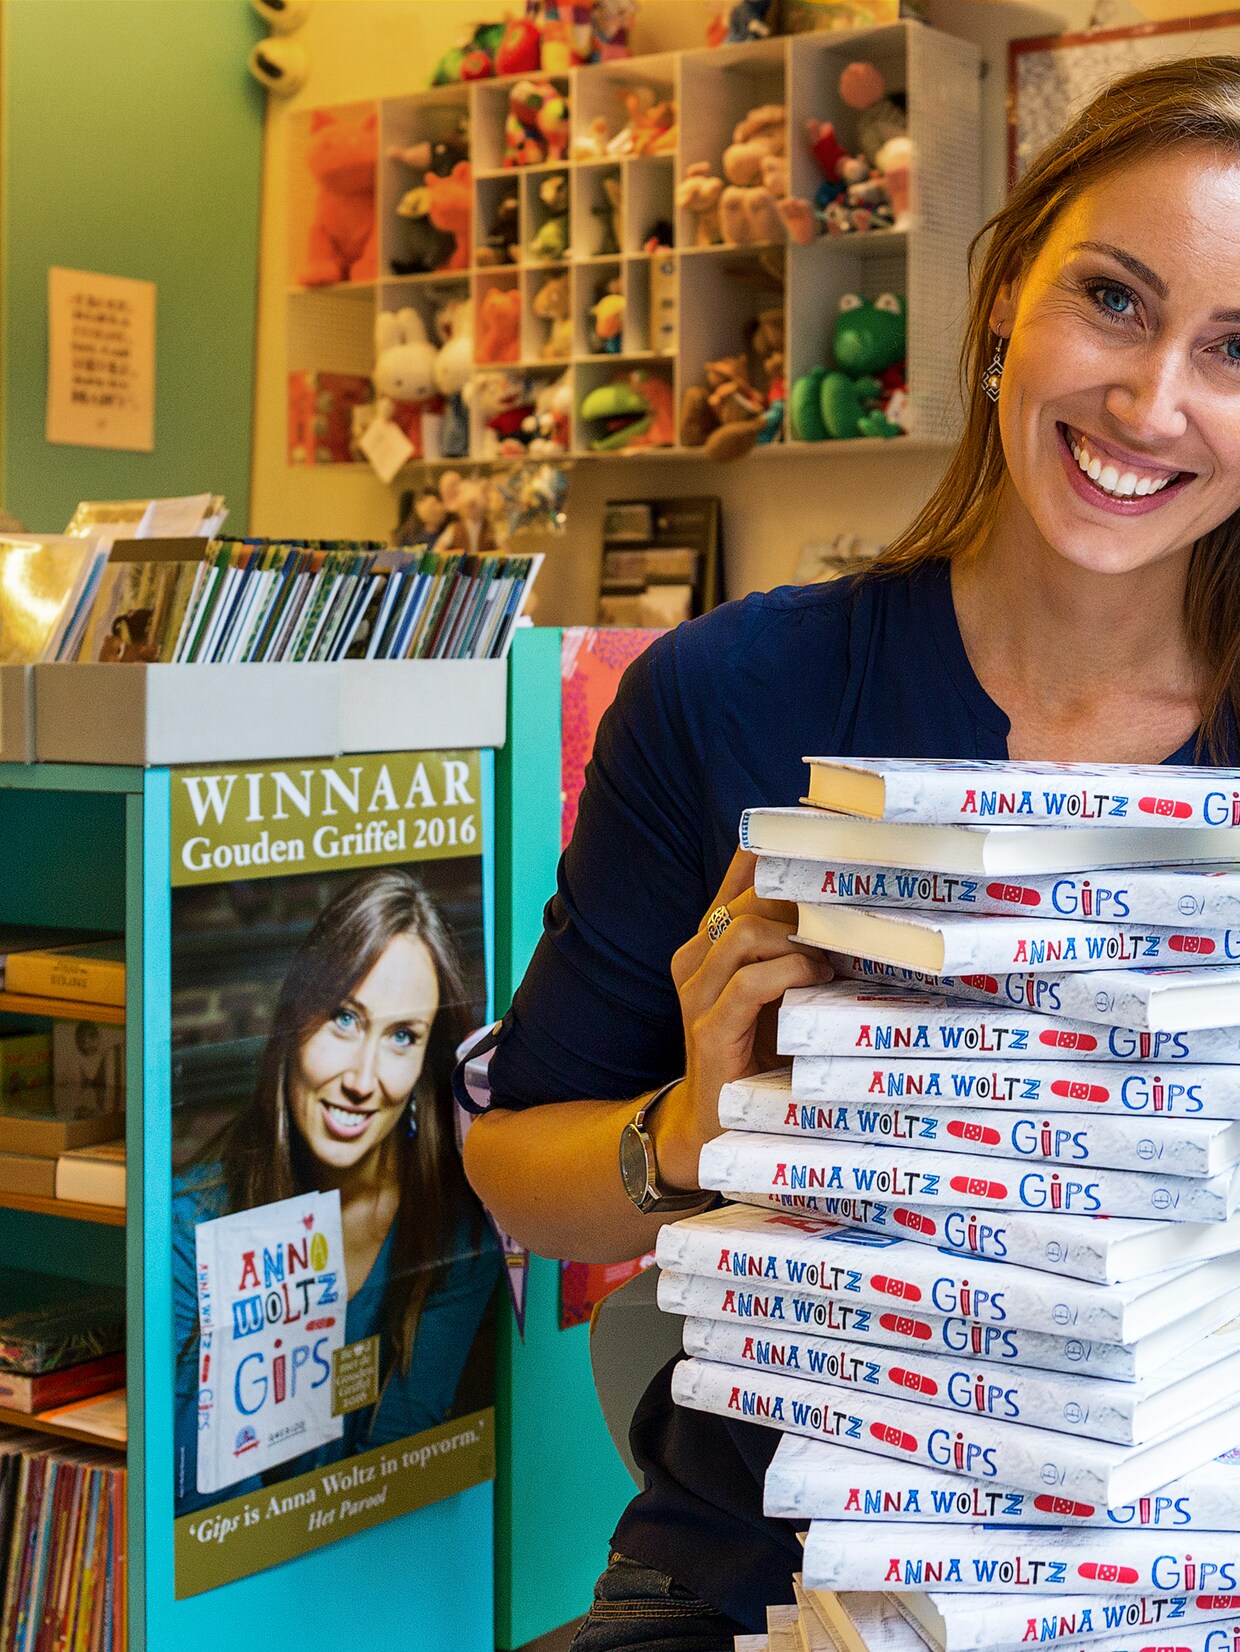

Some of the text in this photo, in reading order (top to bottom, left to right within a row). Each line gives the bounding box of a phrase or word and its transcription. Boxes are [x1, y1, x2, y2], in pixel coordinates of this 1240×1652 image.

[180, 760, 477, 828] WINNAAR
[960, 789, 1034, 817] ANNA
[1042, 790, 1130, 819] WOLTZ
[181, 814, 478, 872] Gouden Griffel 2016
[820, 870, 888, 898] ANNA
[896, 873, 980, 903] WOLTZ
[1012, 936, 1078, 966] ANNA
[1085, 932, 1162, 961] WOLTZ
[855, 1024, 931, 1050] ANNA
[938, 1023, 1031, 1051] WOLTZ
[867, 1071, 944, 1097] ANNA
[951, 1072, 1042, 1101] WOLTZ
[783, 1103, 850, 1130] ANNA
[857, 1108, 940, 1140] WOLTZ
[771, 1163, 845, 1190] ANNA
[852, 1167, 941, 1197] WOLTZ
[824, 1197, 889, 1226] WOLTZ
[238, 1231, 330, 1292] ANNA
[716, 1248, 779, 1281] ANNA
[785, 1258, 864, 1294] WOLTZ
[231, 1271, 339, 1340] WOLTZ
[721, 1290, 786, 1321] ANNA
[792, 1300, 873, 1333] WOLTZ
[741, 1336, 801, 1369] ANNA
[807, 1348, 881, 1385] WOLTZ
[727, 1386, 785, 1421] ANNA
[791, 1400, 863, 1440] WOLTZ
[242, 1503, 260, 1526] is
[265, 1488, 317, 1521] Anna
[321, 1461, 377, 1496] Woltz
[379, 1454, 398, 1476] in
[844, 1487, 922, 1514] ANNA
[930, 1487, 1025, 1517] WOLTZ
[307, 1506, 335, 1532] Het
[883, 1557, 964, 1585] ANNA
[972, 1556, 1068, 1586] WOLTZ
[1021, 1597, 1188, 1643] ANNA WOLTZ
